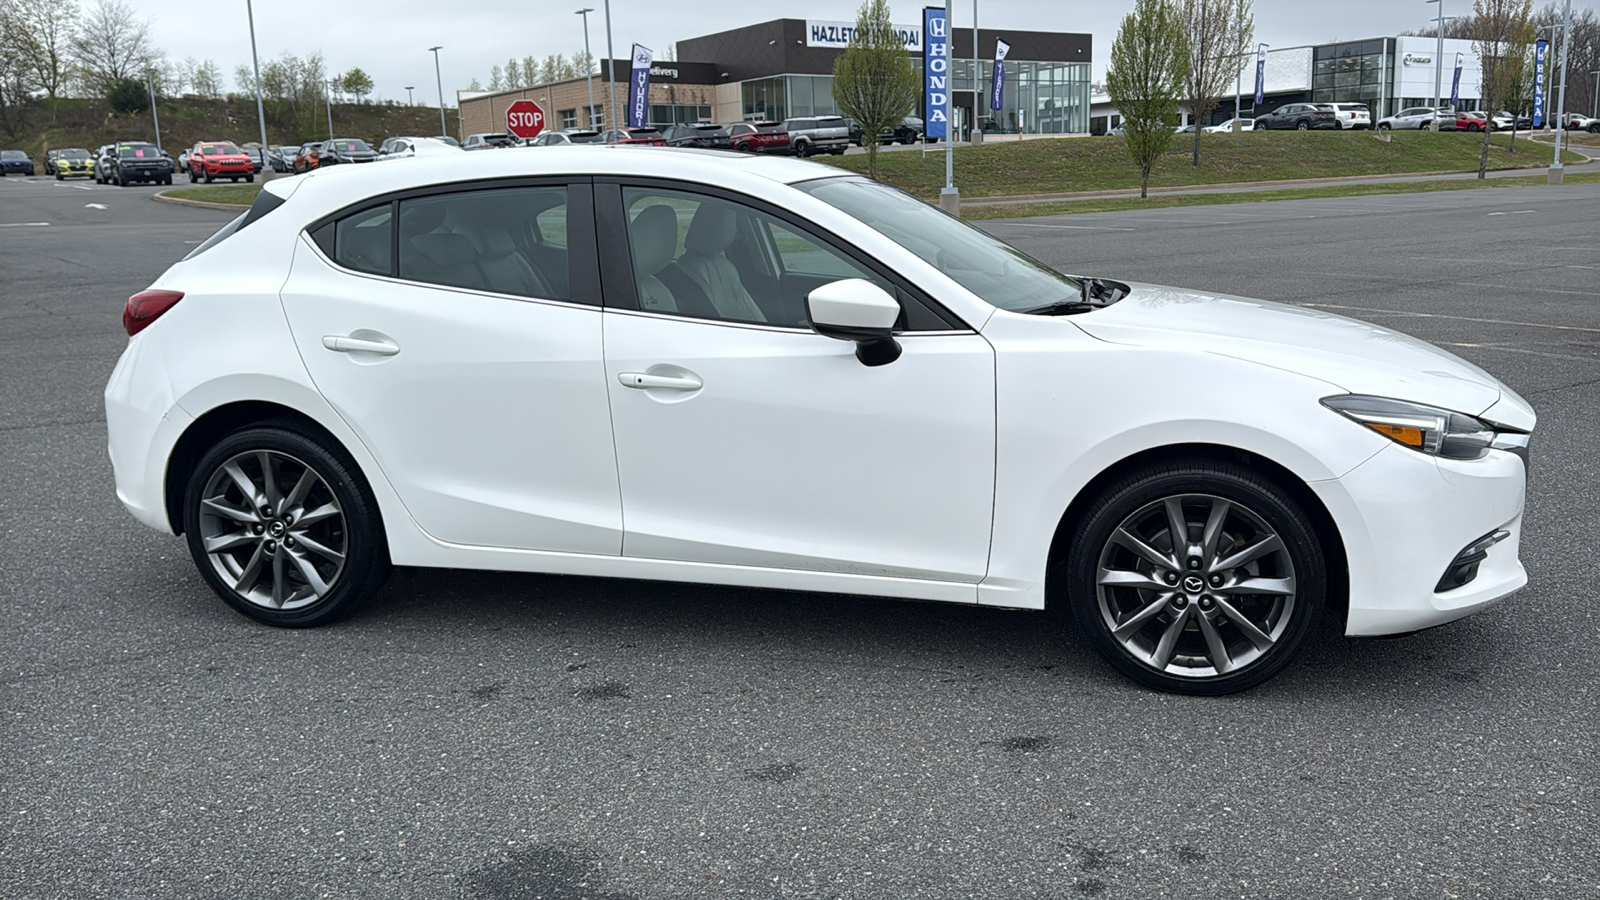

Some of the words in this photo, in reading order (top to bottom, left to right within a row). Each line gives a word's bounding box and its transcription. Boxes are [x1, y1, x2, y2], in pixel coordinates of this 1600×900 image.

[650, 66, 678, 79] elivery
[929, 43, 946, 122] HONDA
[1534, 64, 1544, 116] HONDA
[509, 112, 542, 127] STOP
[635, 71, 647, 127] HYUNDAI
